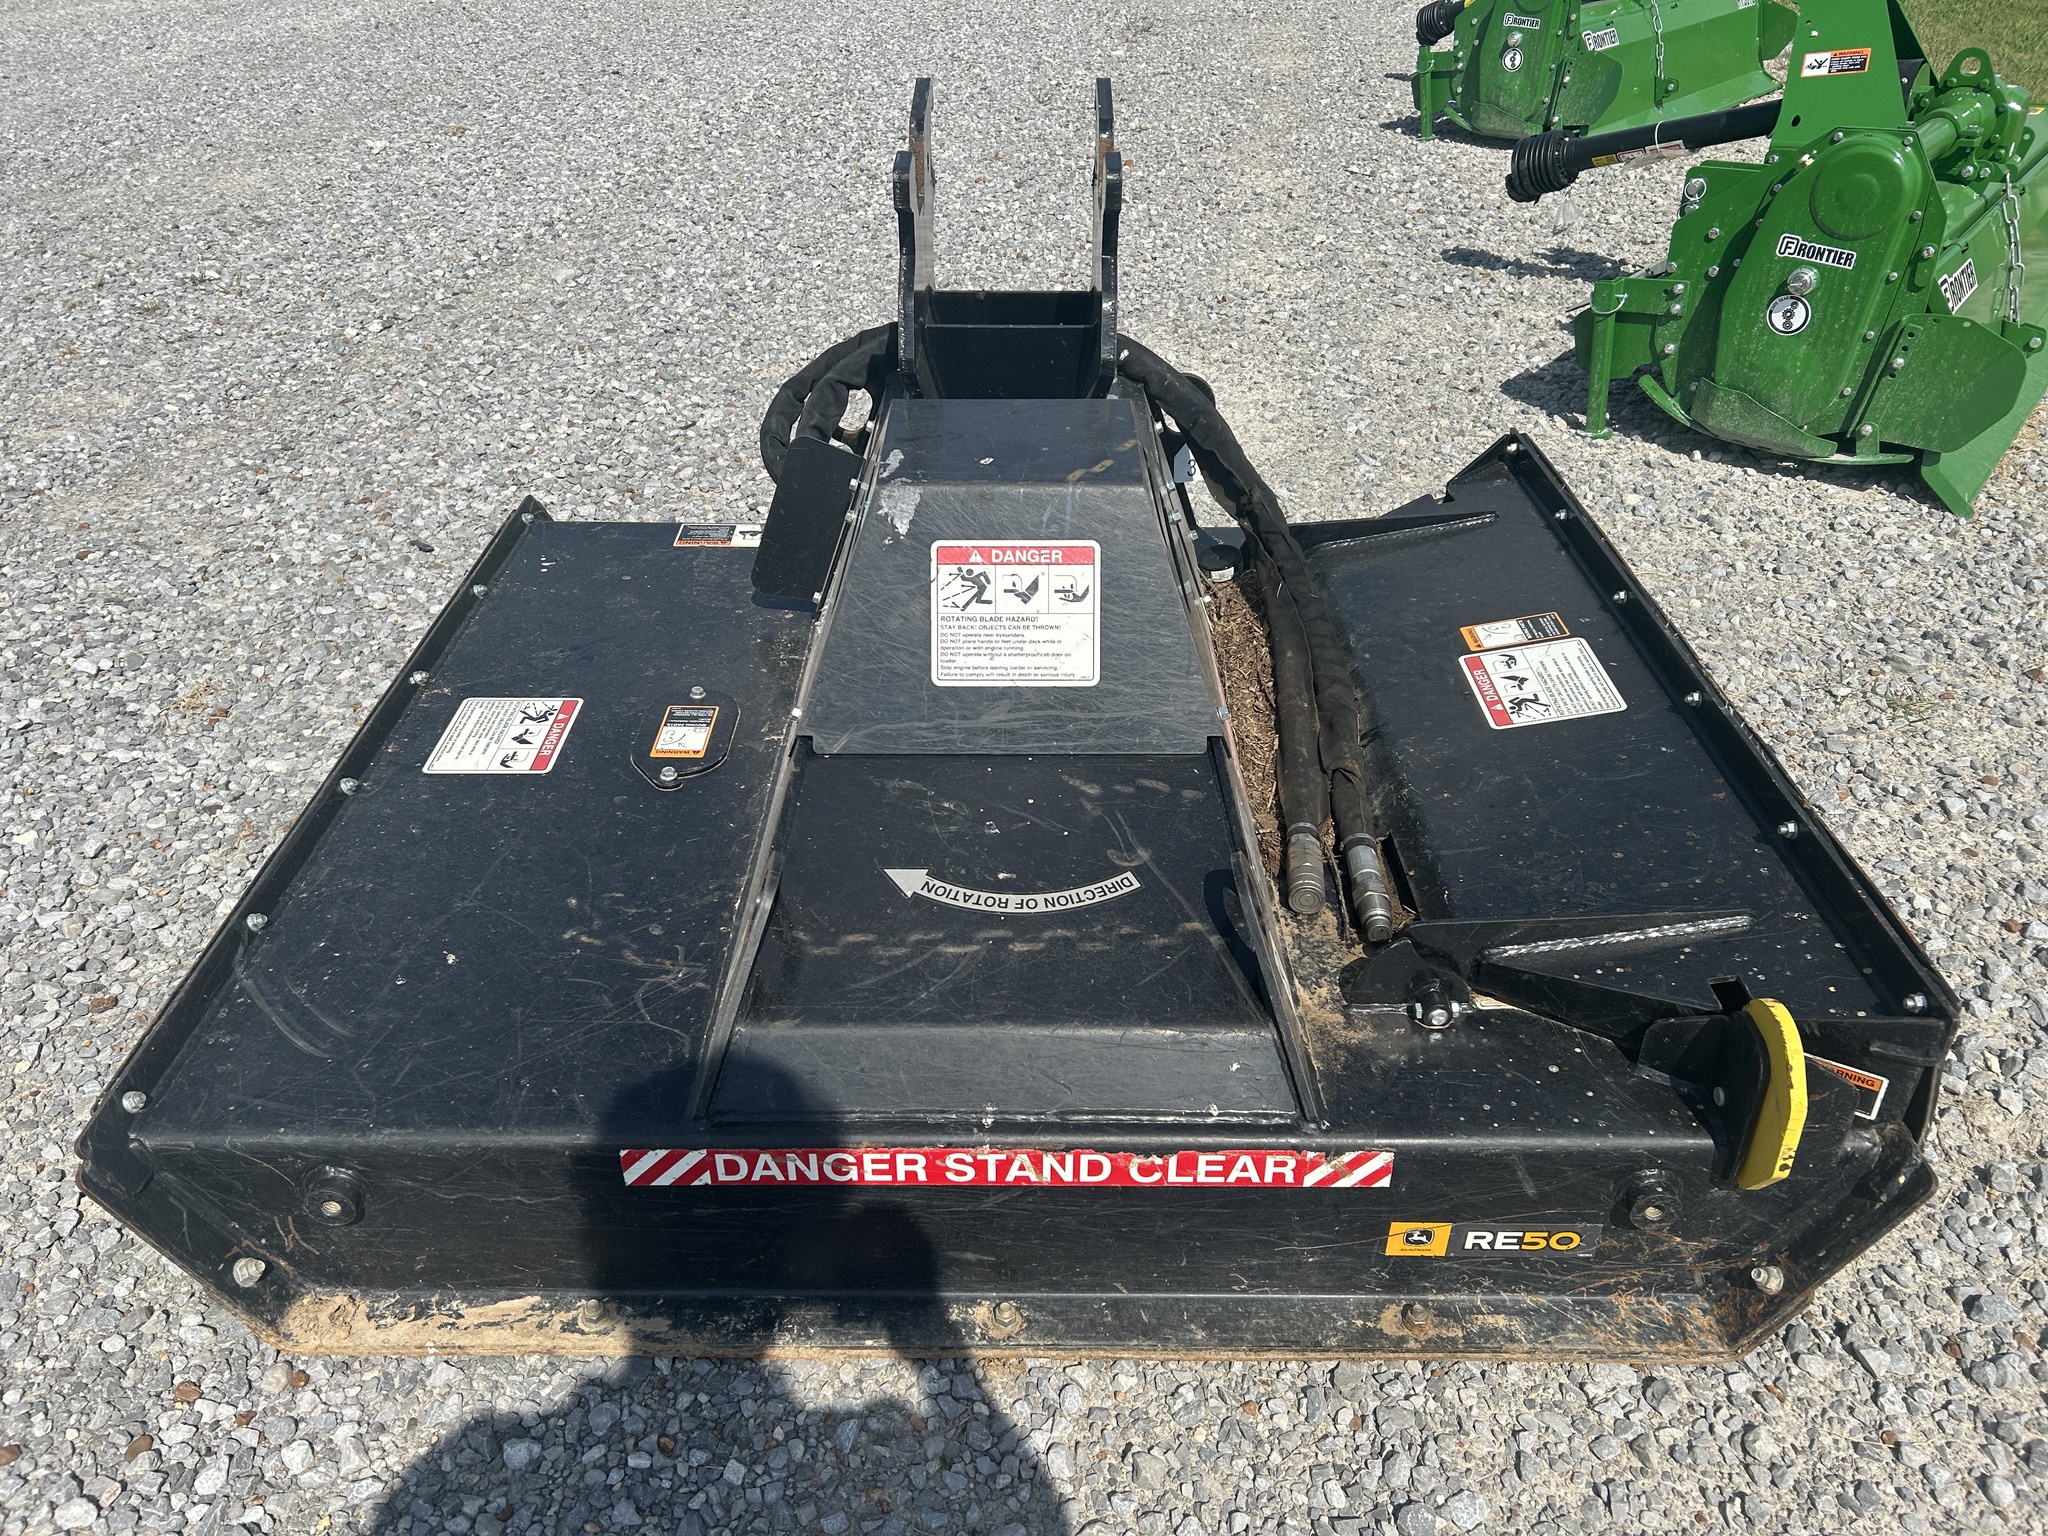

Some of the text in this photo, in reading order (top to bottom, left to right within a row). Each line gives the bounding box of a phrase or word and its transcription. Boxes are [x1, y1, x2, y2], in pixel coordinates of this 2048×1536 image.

[1504, 14, 1540, 28] FRONTIER
[1584, 30, 1618, 50] FRONTIER
[1778, 236, 1854, 267] FRONTIER
[1940, 260, 1977, 312] FRONTIER
[1187, 459, 1196, 476] 3
[992, 550, 1062, 563] DANGER
[1474, 670, 1498, 701] DANGER
[539, 723, 564, 756] DANGER
[920, 876, 1134, 910] DIRECTION OF ROTATION
[714, 1152, 1296, 1183] DANGER STAND CLEAR
[1464, 1231, 1581, 1250] RE50
